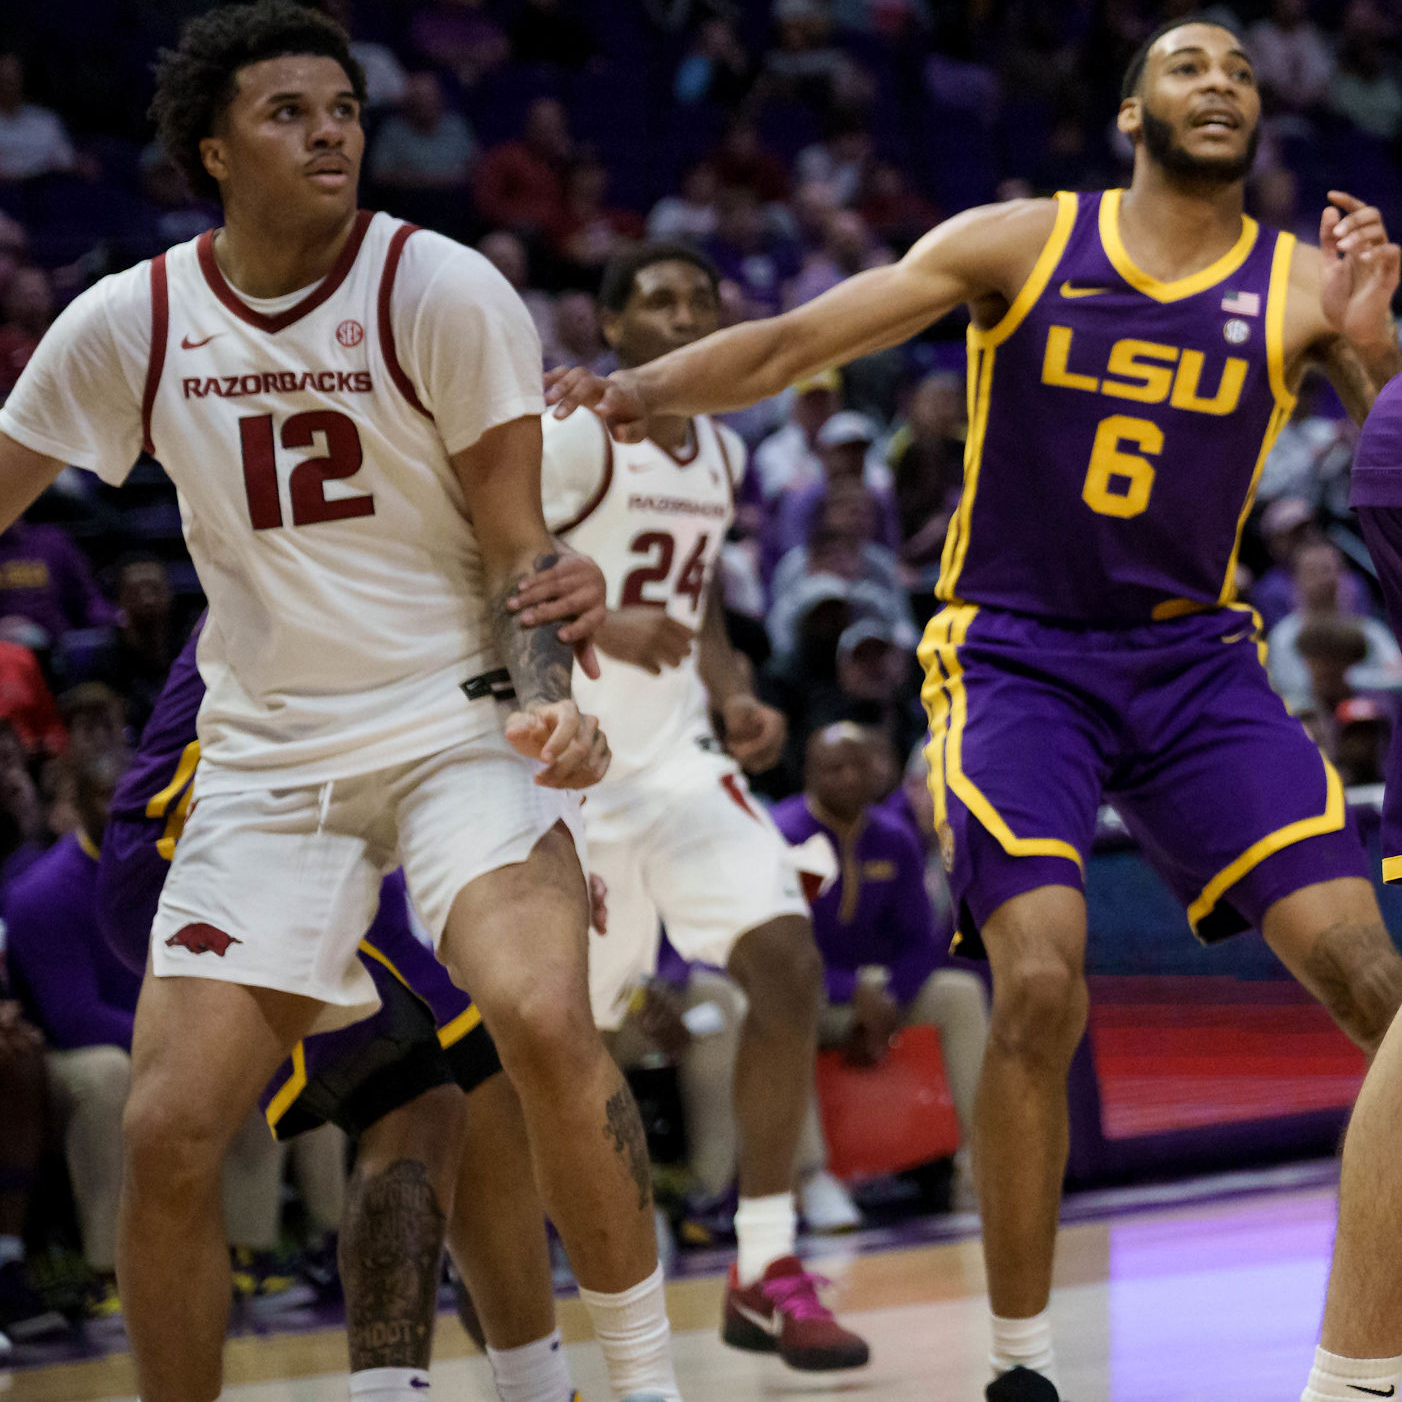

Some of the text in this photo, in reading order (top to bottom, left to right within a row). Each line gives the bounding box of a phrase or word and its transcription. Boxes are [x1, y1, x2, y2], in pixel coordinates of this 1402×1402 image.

[337, 321, 364, 347] SEC
[1041, 325, 1249, 416] LSU
[183, 371, 373, 399] RAZORBACKS
[238, 409, 376, 530] 12
[1081, 414, 1164, 519] 6
[619, 529, 708, 612] 24
